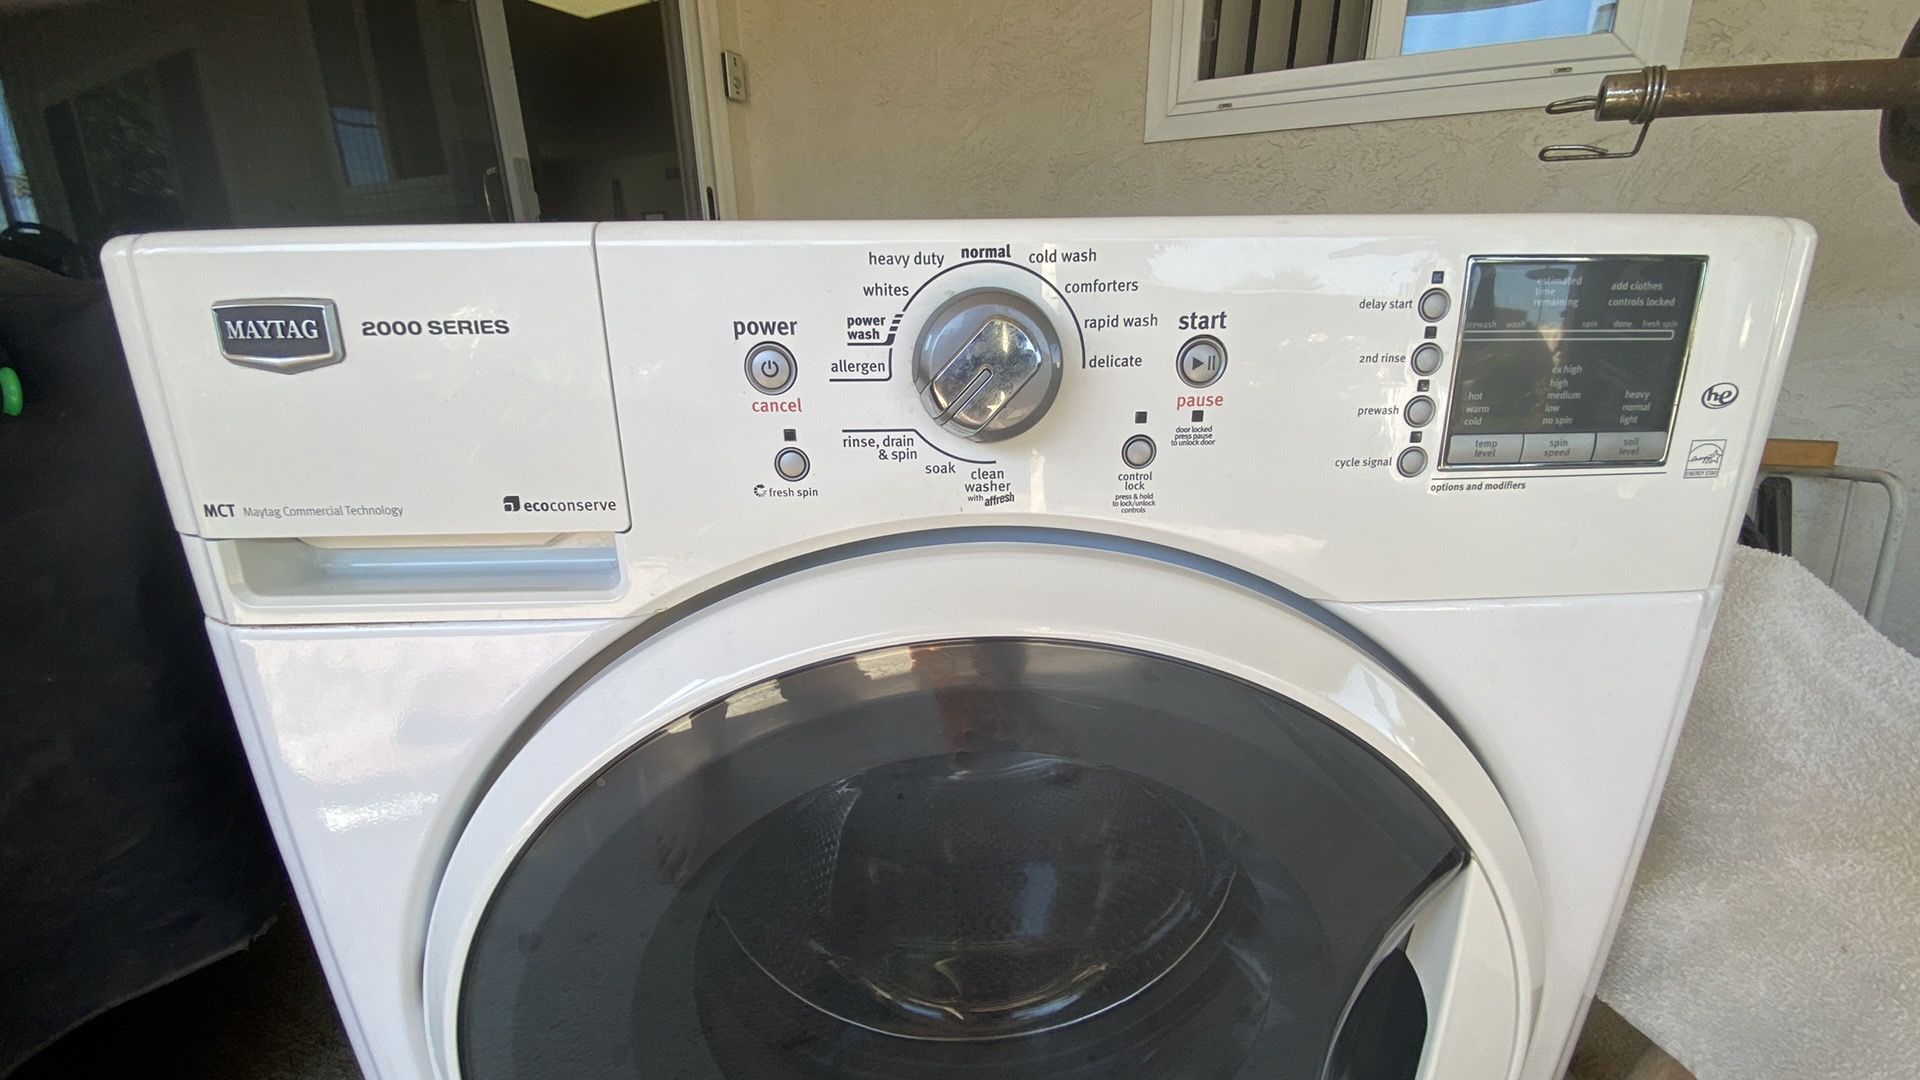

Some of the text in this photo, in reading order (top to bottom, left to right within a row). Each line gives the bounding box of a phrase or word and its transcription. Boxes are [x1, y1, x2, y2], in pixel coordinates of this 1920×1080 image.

[961, 244, 1011, 259] normal
[1029, 249, 1097, 263] cold wash
[868, 252, 945, 268] heavy duty
[863, 283, 909, 297] whites
[1064, 279, 1139, 294] comforters
[1535, 287, 1556, 296] time
[1611, 280, 1663, 291] add clothes
[1359, 298, 1413, 311] delay start
[1608, 297, 1676, 307] controls locked
[847, 315, 886, 328] power
[1084, 314, 1158, 331] rapid wash
[1178, 311, 1228, 330] start
[1506, 319, 1526, 329] wash
[1582, 319, 1598, 329] spin
[1613, 318, 1633, 328] done
[224, 318, 320, 341] MAYTAG
[361, 319, 510, 337] 2000 SERIES
[733, 319, 798, 340] power
[848, 329, 880, 340] wash
[1089, 355, 1142, 368] delicate
[1359, 353, 1406, 364] 2nd rinse
[831, 360, 886, 375] allergen
[1552, 362, 1583, 374] ex high
[1550, 379, 1569, 388] high
[1468, 392, 1483, 401] hot
[1547, 390, 1582, 400] medium
[1624, 390, 1650, 400] heavy
[1705, 388, 1733, 405] he
[751, 398, 803, 413] cancel
[1176, 394, 1224, 411] pause
[1545, 404, 1560, 413] low
[1622, 402, 1650, 412] normal
[1357, 406, 1400, 418] prewash
[1466, 405, 1489, 413] warm
[1464, 416, 1482, 426] cold
[1542, 415, 1573, 426] no spin
[1619, 414, 1638, 425] light
[842, 435, 914, 450] rinse, drain
[1475, 439, 1498, 449] temp
[1549, 439, 1568, 449] spin
[1623, 438, 1639, 446] soil
[878, 448, 918, 463] & spin
[1474, 449, 1496, 458] level
[1543, 448, 1570, 458] speed
[1335, 455, 1392, 468] cycle signal
[925, 462, 956, 474] soak
[970, 468, 1005, 480] clean
[1118, 472, 1153, 482] control
[964, 480, 1012, 493] washer
[1124, 481, 1145, 491] lock
[1430, 479, 1526, 493] options and modifiers
[768, 486, 819, 500] fresh spin
[524, 500, 616, 511] ecoconserve
[967, 492, 1015, 507] with affresh
[203, 503, 404, 519] MCT Maytag Commercial Technology
[1121, 506, 1146, 514] controls
